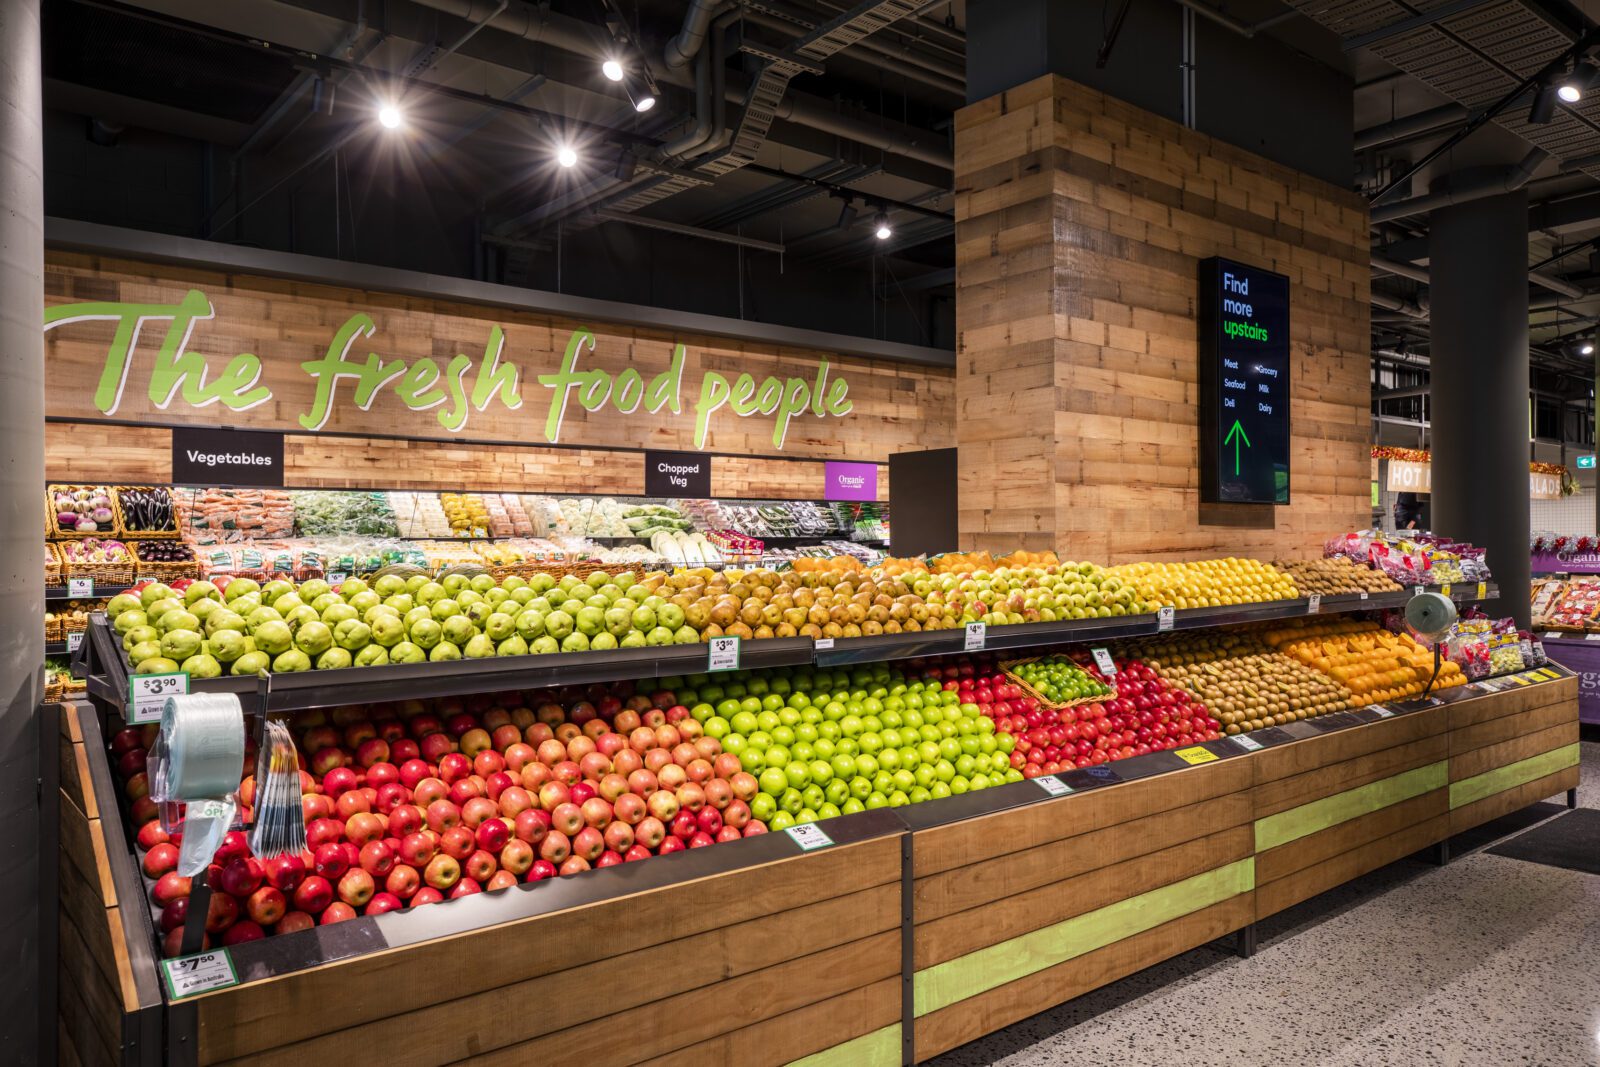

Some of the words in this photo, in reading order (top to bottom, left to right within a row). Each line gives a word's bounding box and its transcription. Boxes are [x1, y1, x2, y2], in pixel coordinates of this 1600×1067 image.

[1224, 272, 1248, 295] Find
[1224, 299, 1252, 317] more
[1224, 320, 1268, 342] upstairs
[44, 289, 273, 416] The
[299, 312, 524, 432] fresh
[538, 326, 687, 444] food
[694, 354, 853, 450] people
[1224, 359, 1239, 369] Meat
[1259, 365, 1278, 377] Grocery
[1224, 379, 1246, 390] Seafood
[1259, 384, 1270, 394] Milk
[1224, 398, 1235, 408] Deli
[1259, 403, 1272, 414] Dairy
[186, 449, 272, 467] Vegetables
[658, 463, 699, 476] Chopped
[670, 475, 687, 487] Veg
[838, 474, 865, 485] Organic
[1392, 466, 1422, 487] HOT
[1530, 477, 1560, 496] ALADS
